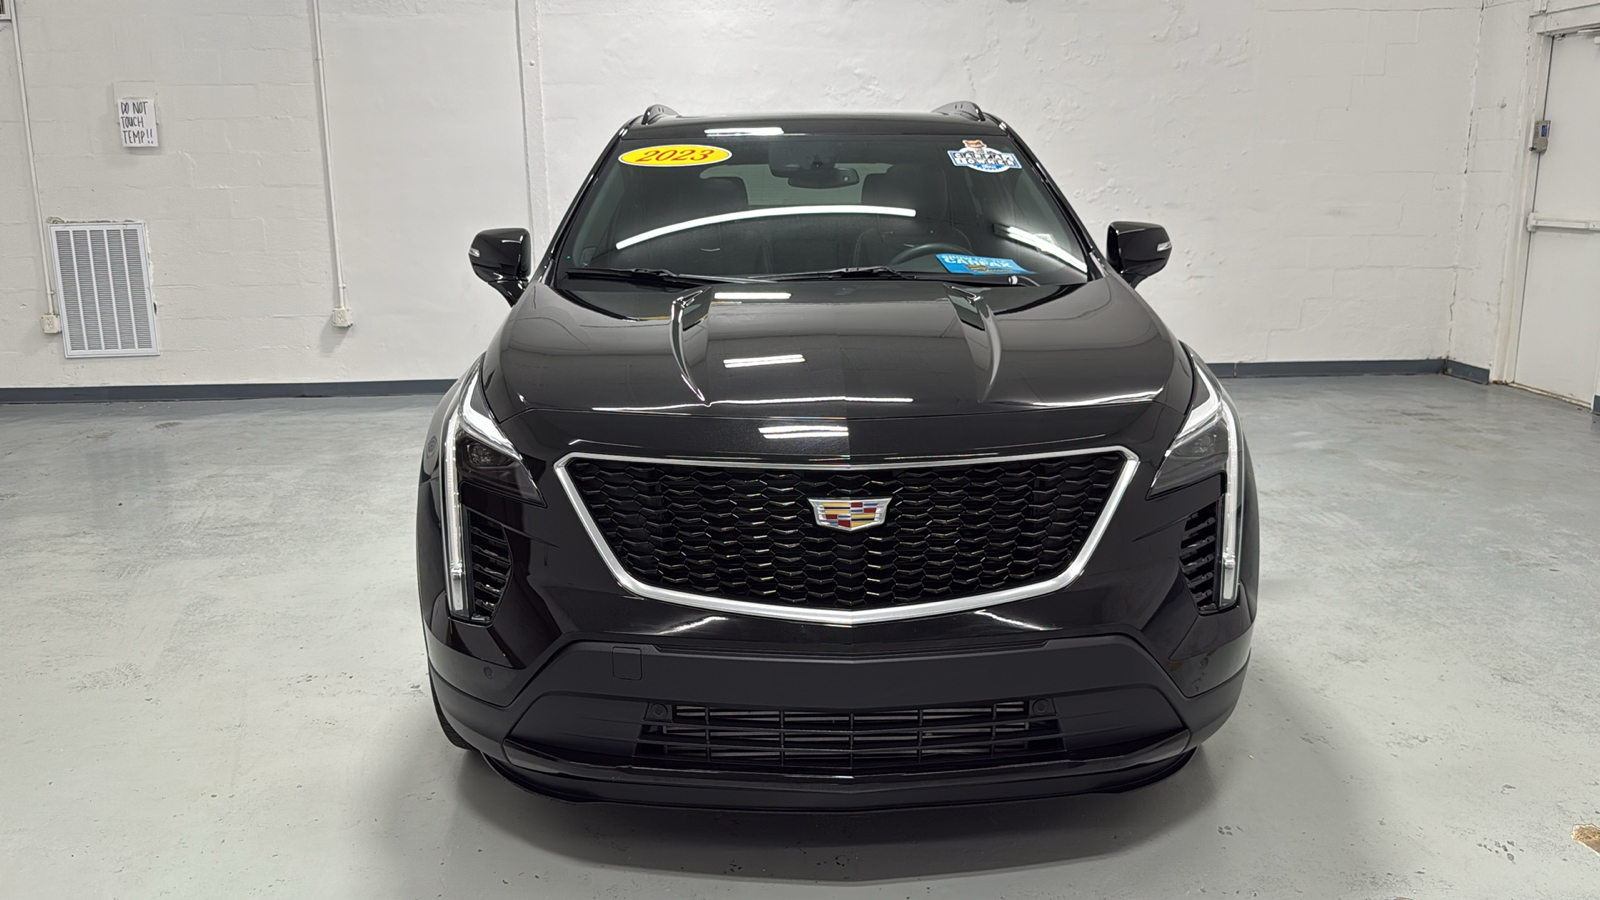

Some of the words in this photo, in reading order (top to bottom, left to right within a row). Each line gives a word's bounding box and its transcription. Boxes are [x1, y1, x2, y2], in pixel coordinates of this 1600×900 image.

[120, 101, 130, 115] DO
[132, 101, 148, 115] NOT
[120, 116, 144, 129] TOUCH
[122, 129, 154, 144] TEMP!!
[635, 149, 715, 162] 2023
